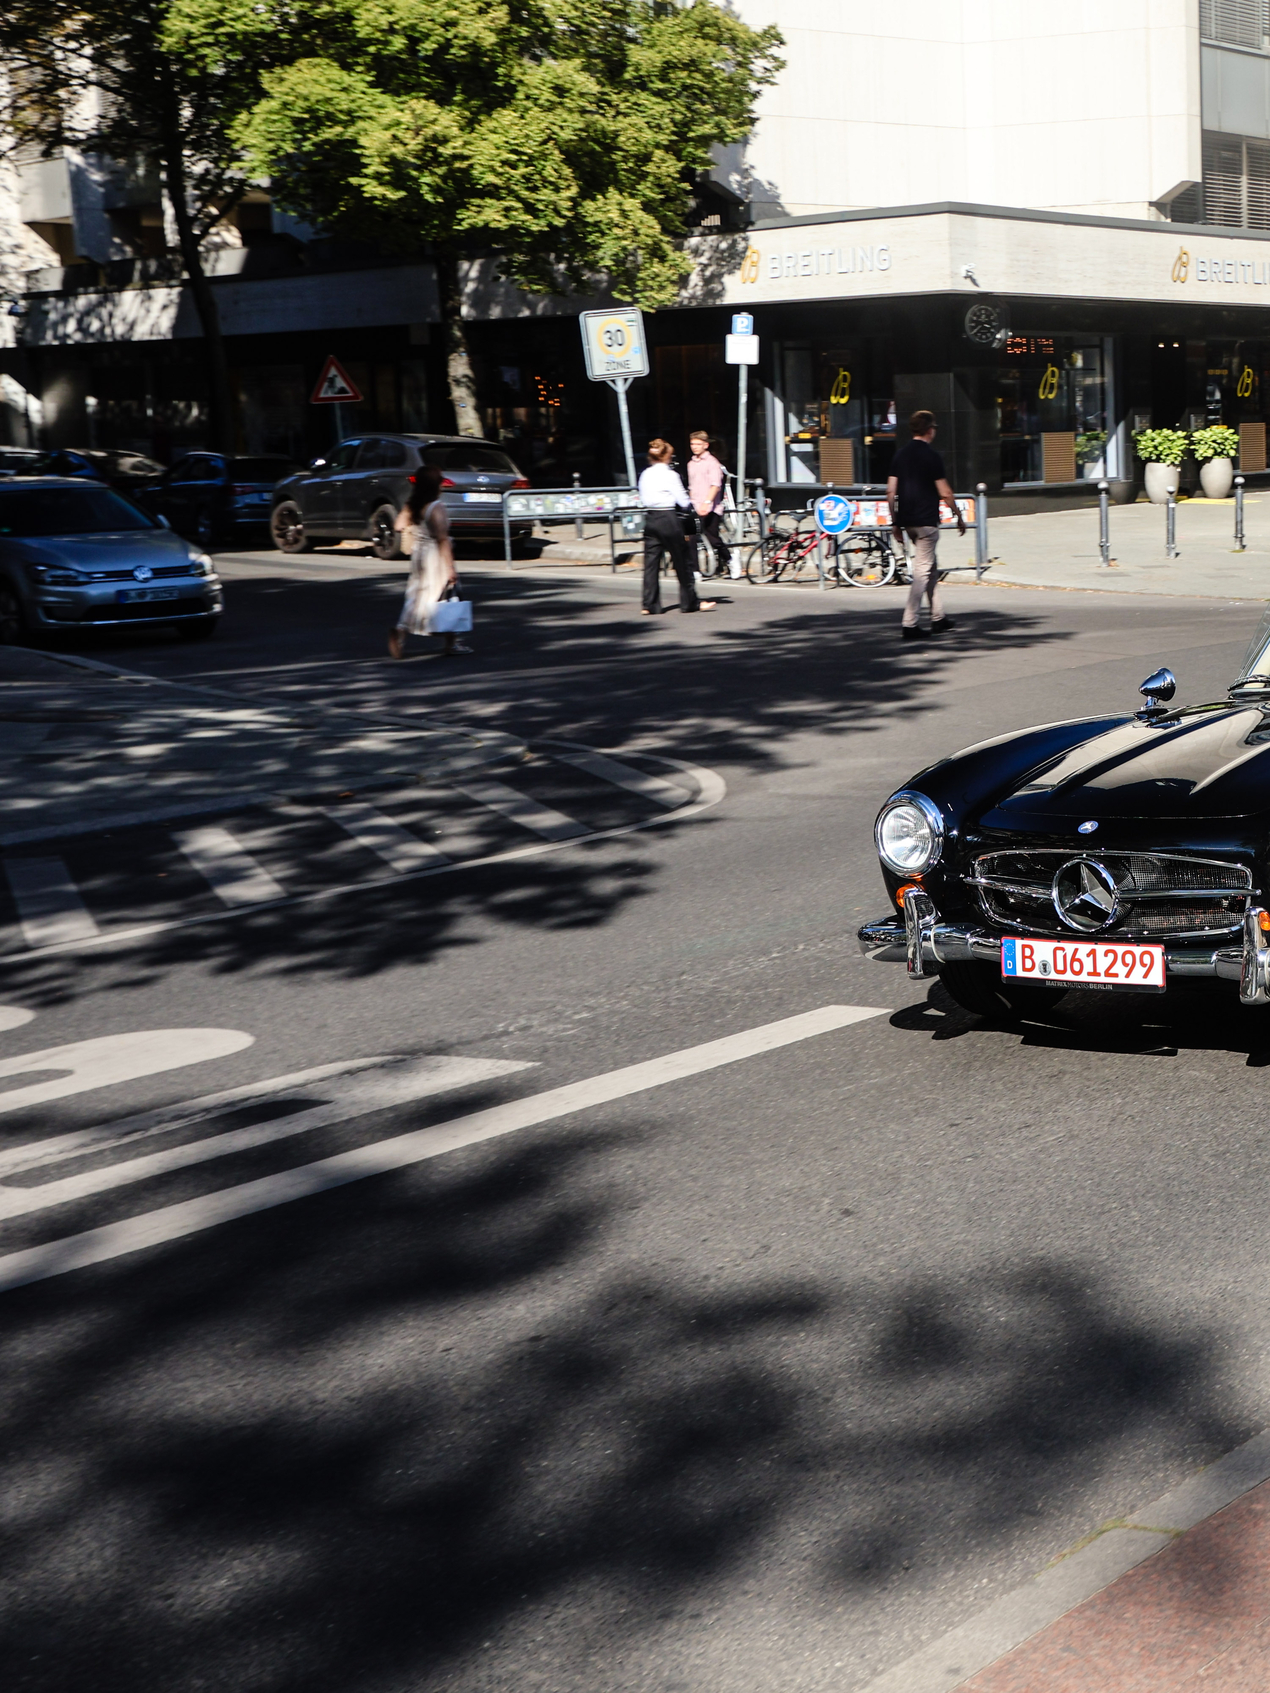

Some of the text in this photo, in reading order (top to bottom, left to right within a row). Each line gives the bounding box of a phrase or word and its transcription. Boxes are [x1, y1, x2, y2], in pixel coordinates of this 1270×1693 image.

[768, 244, 892, 280] BREITLING
[603, 328, 625, 348] 30
[1021, 943, 1036, 972] B
[1052, 946, 1155, 979] 061299
